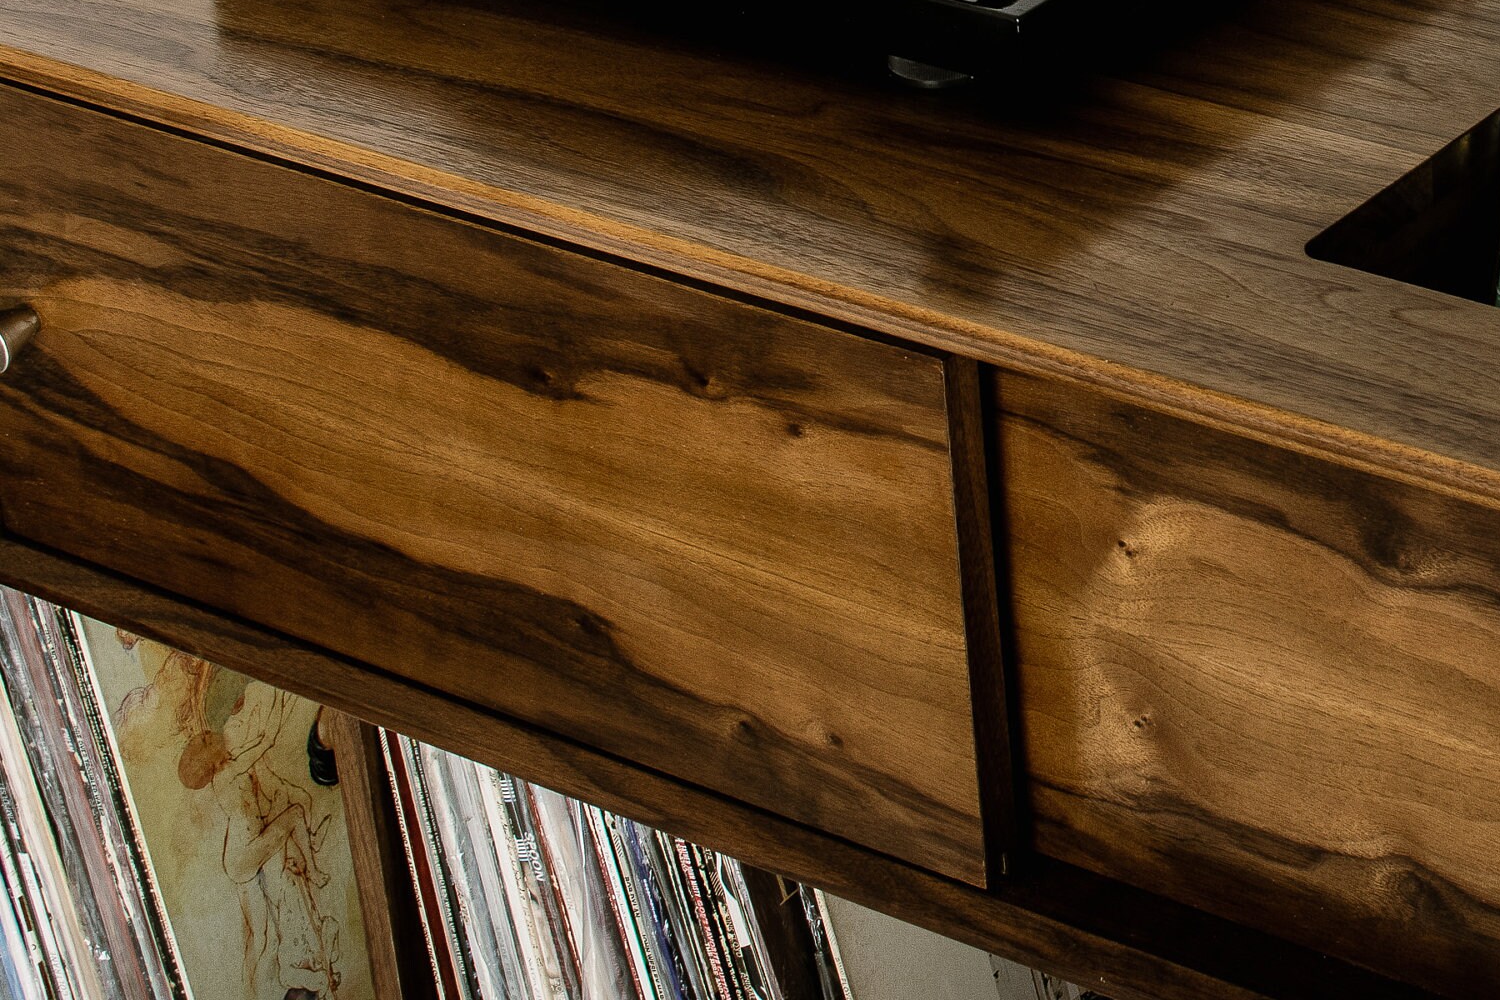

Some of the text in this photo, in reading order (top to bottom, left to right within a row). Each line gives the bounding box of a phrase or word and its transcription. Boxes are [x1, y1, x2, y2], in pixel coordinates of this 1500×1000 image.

[522, 829, 545, 883] SPOON
[689, 878, 701, 899] MISTY
[629, 892, 640, 918] DYLAN
[641, 933, 651, 953] JOHN
[646, 952, 660, 985] WESLEY
[729, 931, 742, 959] FLOYD
